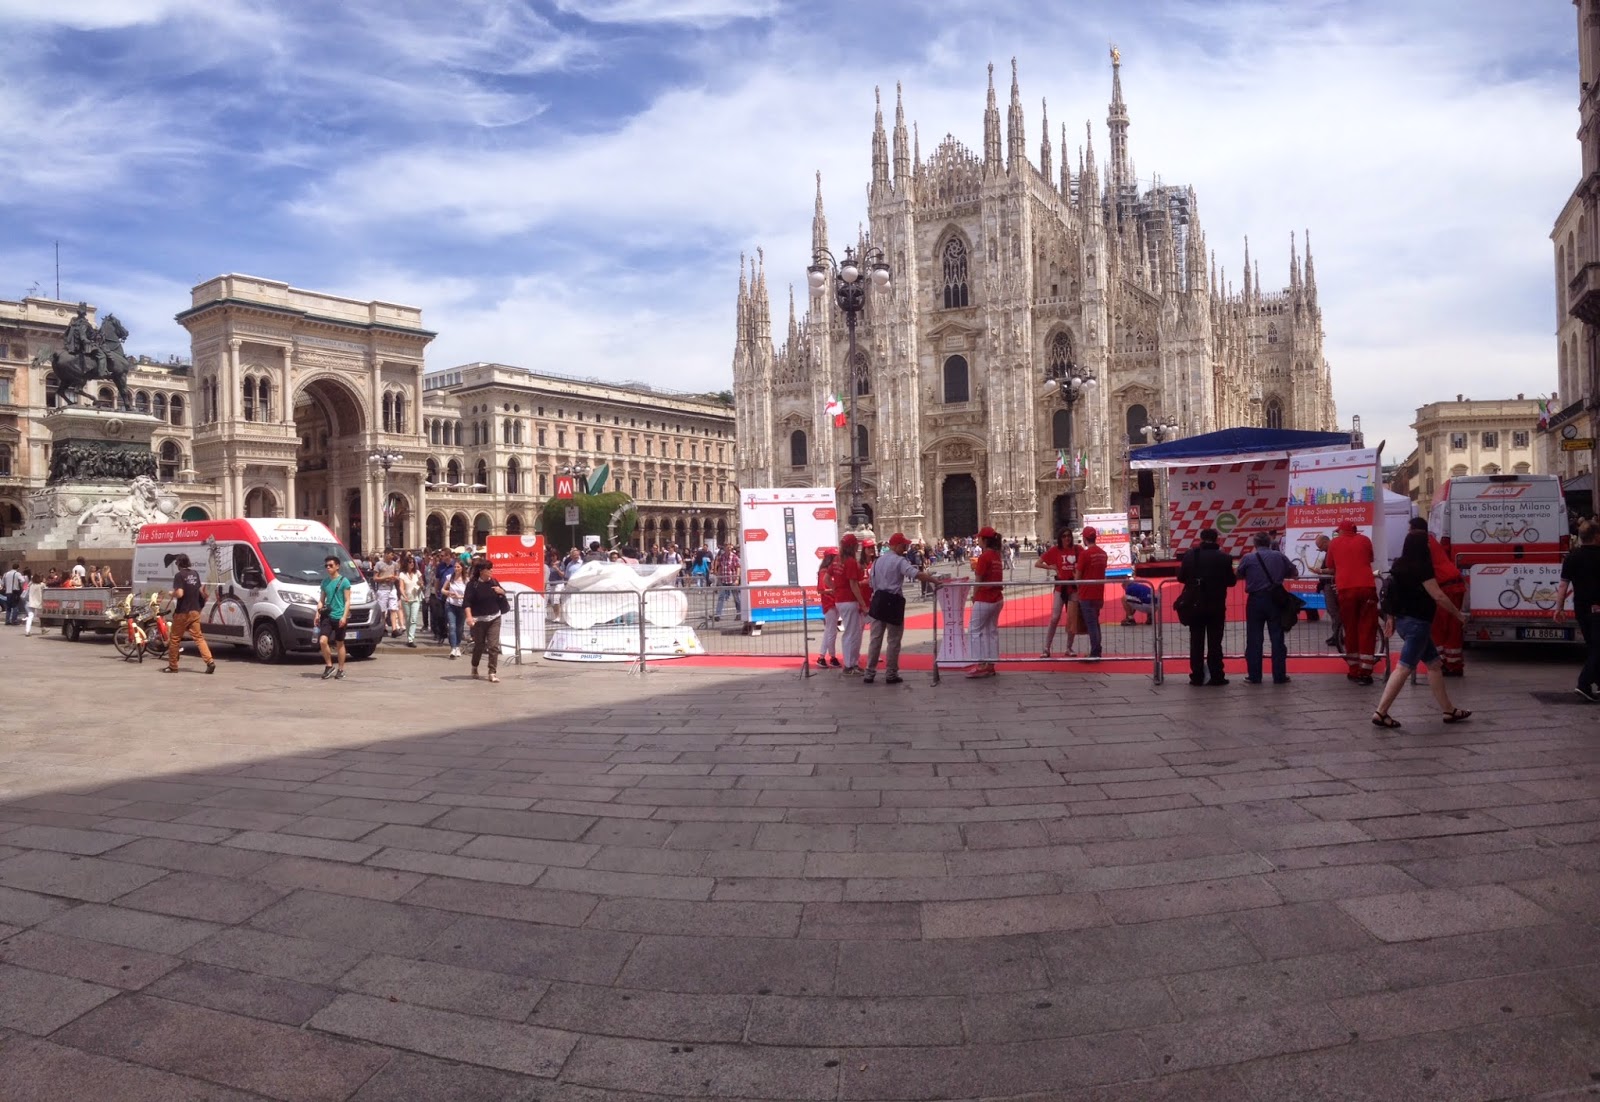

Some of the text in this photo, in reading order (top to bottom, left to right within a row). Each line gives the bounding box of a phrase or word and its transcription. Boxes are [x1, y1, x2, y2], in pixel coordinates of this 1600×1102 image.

[558, 480, 572, 494] M
[1182, 481, 1216, 491] EXPO
[1316, 507, 1338, 515] Sistema
[1339, 506, 1366, 515] Integrato
[1482, 503, 1515, 512] Sharing
[1519, 502, 1551, 511] Milano
[1314, 516, 1336, 525] Sharing
[150, 530, 174, 541] Sharing
[175, 528, 199, 538] Milano
[1513, 566, 1534, 575] Bike
[780, 597, 804, 605] Sharing
[944, 587, 952, 619] DRIVE
[1526, 629, 1536, 638] XA
